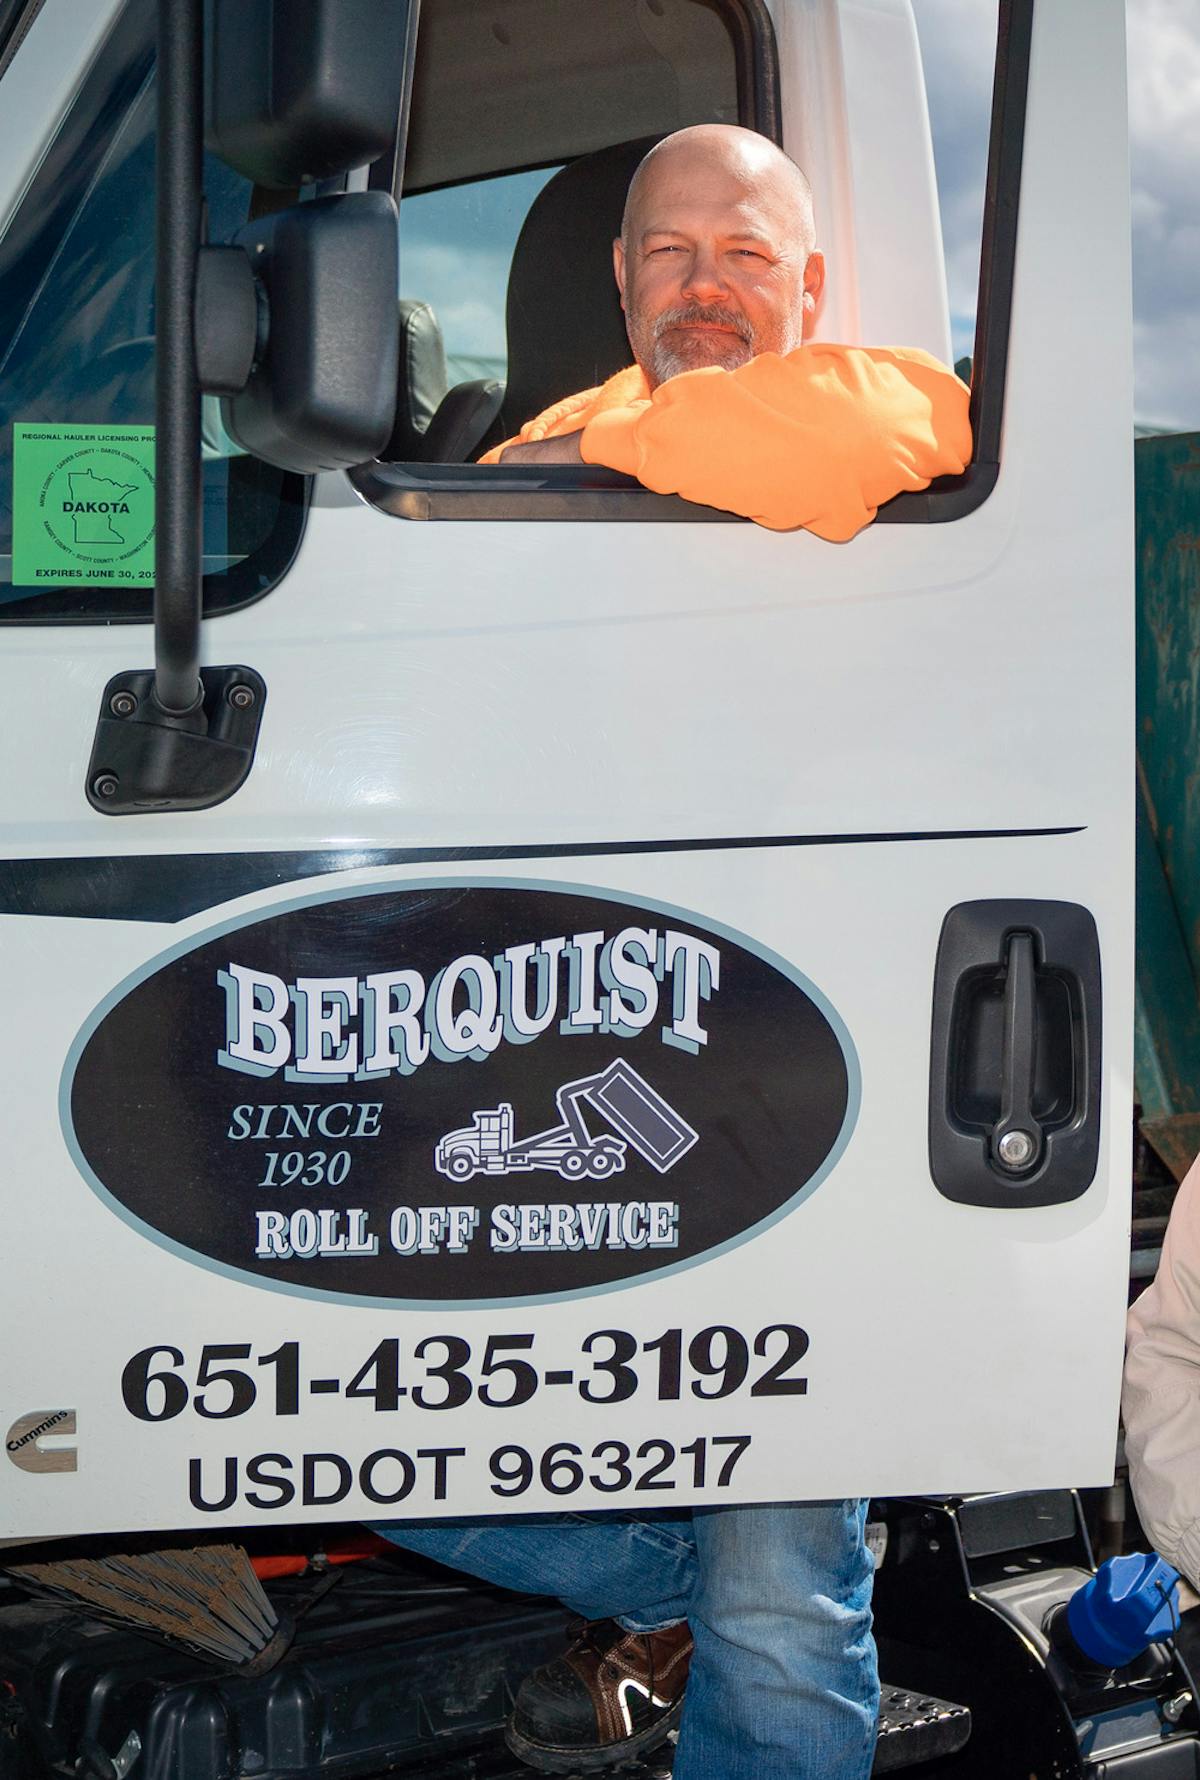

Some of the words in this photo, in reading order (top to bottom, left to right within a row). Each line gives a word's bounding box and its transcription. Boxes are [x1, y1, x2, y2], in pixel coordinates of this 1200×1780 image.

[43, 472, 55, 489] COUNTY
[74, 448, 94, 457] COUNTY
[101, 447, 120, 456] DAKOTA
[121, 452, 140, 465] COUNTY
[63, 501, 130, 514] DAKOTA
[55, 538, 72, 554] COUNTY
[119, 540, 148, 560] WASHINGTON
[36, 569, 82, 577] EXPIRES
[86, 570, 115, 578] JUNE
[118, 570, 135, 580] 30,
[217, 926, 721, 1084] BERQUIST
[227, 1102, 383, 1141] SINCE
[257, 1150, 353, 1188] 1930
[255, 1208, 377, 1259] ROLL
[390, 1205, 480, 1255] OFF
[490, 1201, 680, 1251] SERVICE
[121, 1324, 811, 1422] 651-435-3192
[6, 1411, 68, 1452] Cummins
[189, 1447, 465, 1512] USDOT
[489, 1435, 752, 1499] 963217
